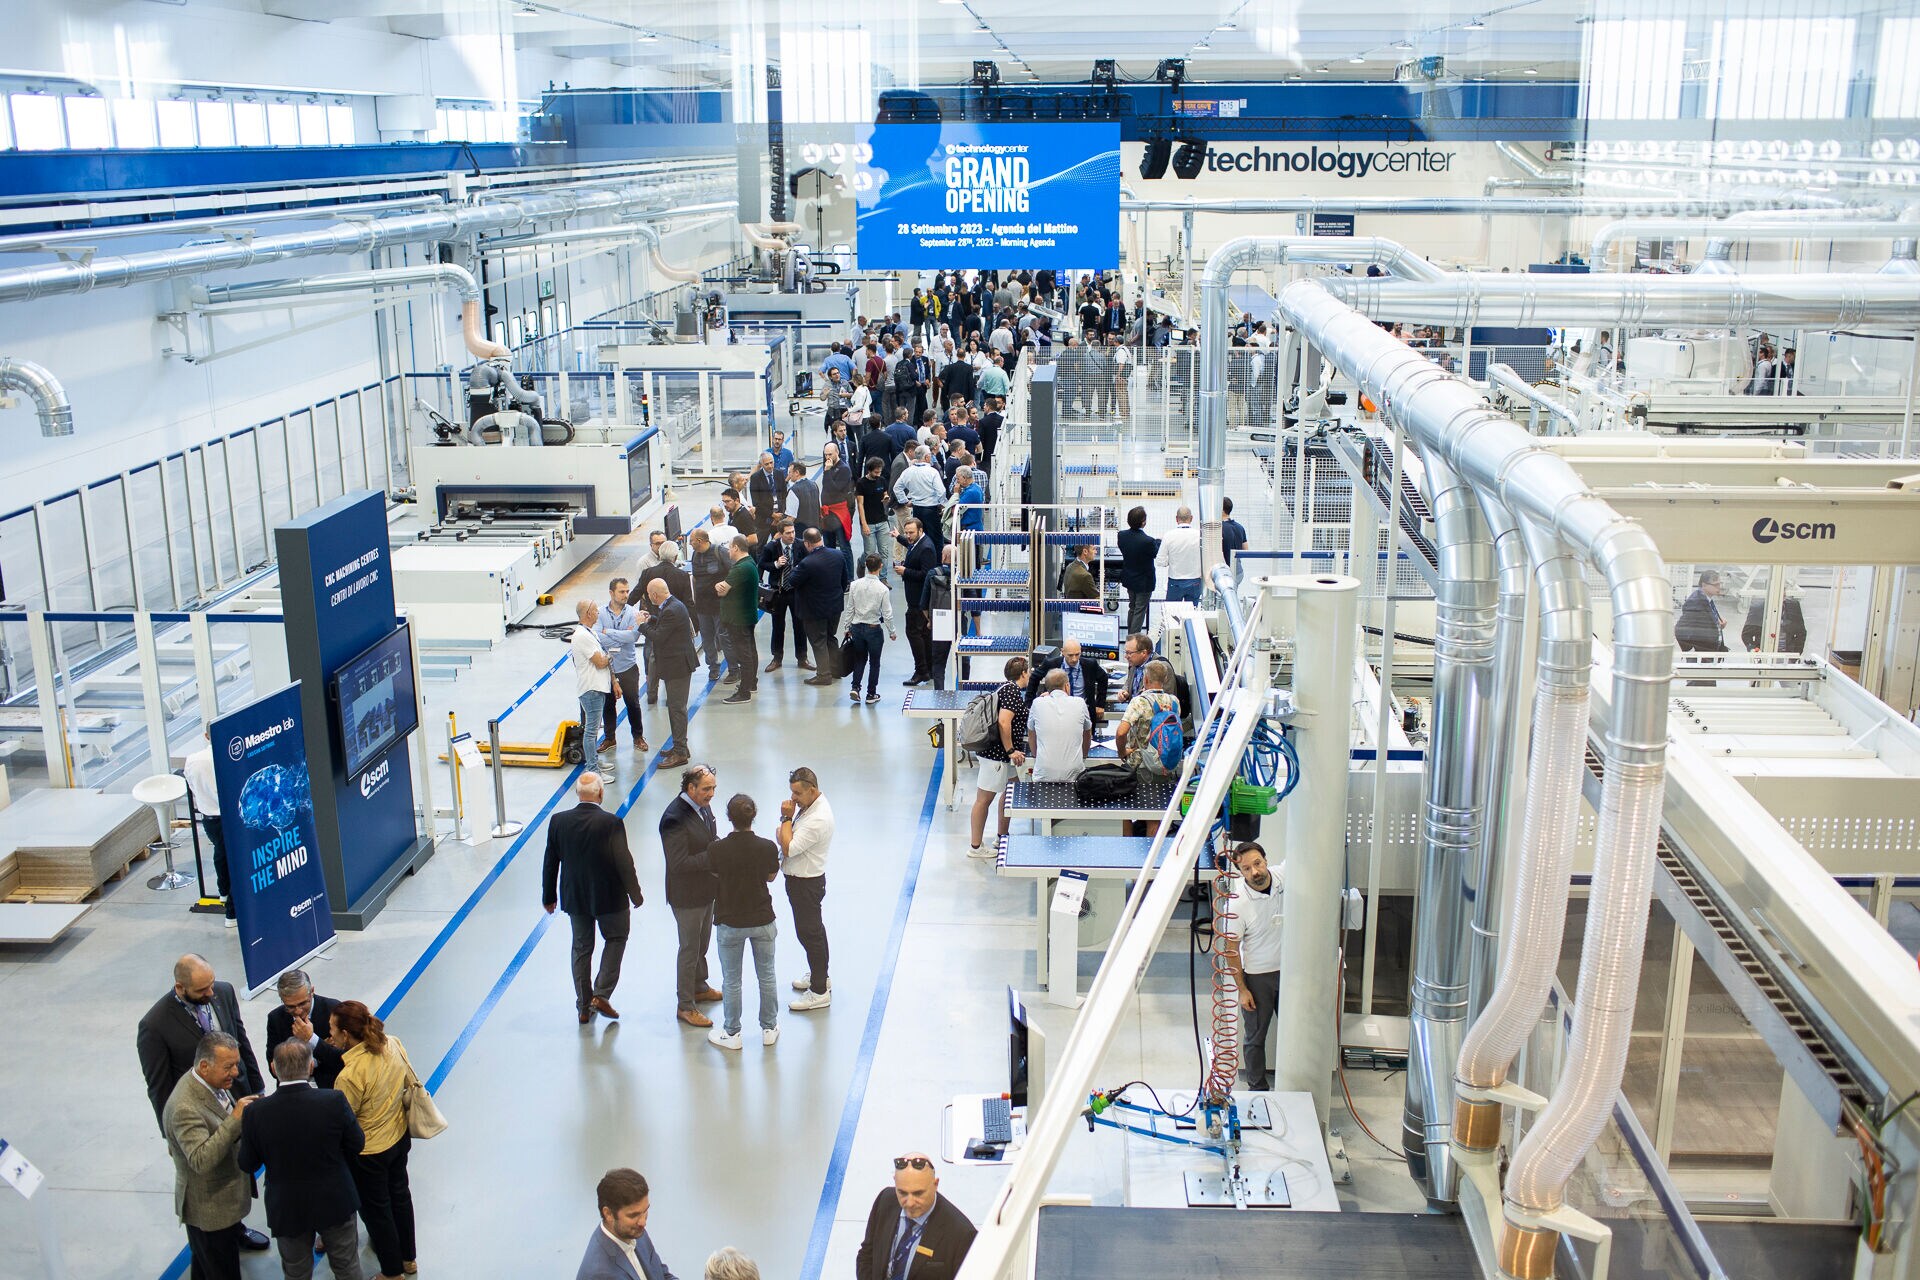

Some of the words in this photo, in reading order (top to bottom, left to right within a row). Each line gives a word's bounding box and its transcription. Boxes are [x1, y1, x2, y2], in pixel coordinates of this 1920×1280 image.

[956, 143, 1029, 155] technologycenter
[1207, 146, 1457, 178] technologycenter
[945, 156, 1030, 188] GRAND
[945, 189, 1030, 213] OPENING
[897, 223, 909, 235] 28
[911, 223, 959, 235] Settembre
[960, 223, 983, 235] 2023
[991, 223, 1026, 236] Agenda
[1027, 223, 1042, 235] del
[1043, 222, 1079, 235] Mattino
[919, 237, 957, 249] September
[976, 238, 994, 247] 2023
[1000, 238, 1028, 248] Morning
[1029, 238, 1056, 248] Agenda
[1780, 522, 1836, 540] scm
[325, 572, 335, 588] CNC
[335, 558, 361, 582] MACHINING
[360, 547, 379, 567] CENTRES
[331, 587, 347, 607] CENTRI
[347, 584, 353, 598] DI
[353, 574, 369, 594] LAVORO
[369, 569, 379, 584] CNC
[244, 724, 282, 749] Maestro
[282, 717, 295, 731] lab
[370, 759, 389, 786] scm
[251, 826, 302, 870] INSPIRE
[250, 865, 275, 894] THE
[276, 845, 308, 880] MIND
[297, 897, 312, 912] scm
